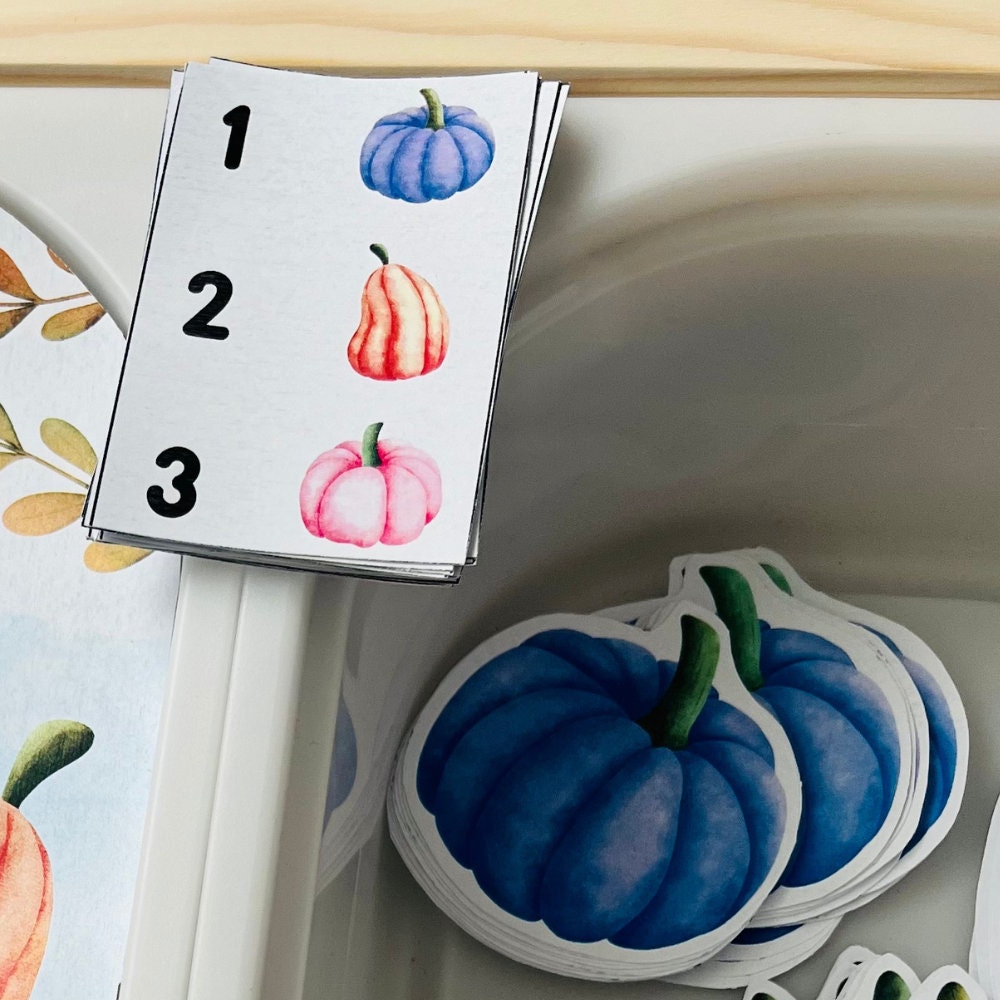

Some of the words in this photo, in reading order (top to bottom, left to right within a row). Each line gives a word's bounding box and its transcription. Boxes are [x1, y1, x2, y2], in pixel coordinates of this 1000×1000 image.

[222, 104, 251, 170] 1
[182, 270, 233, 341] 2
[146, 446, 201, 519] 3
